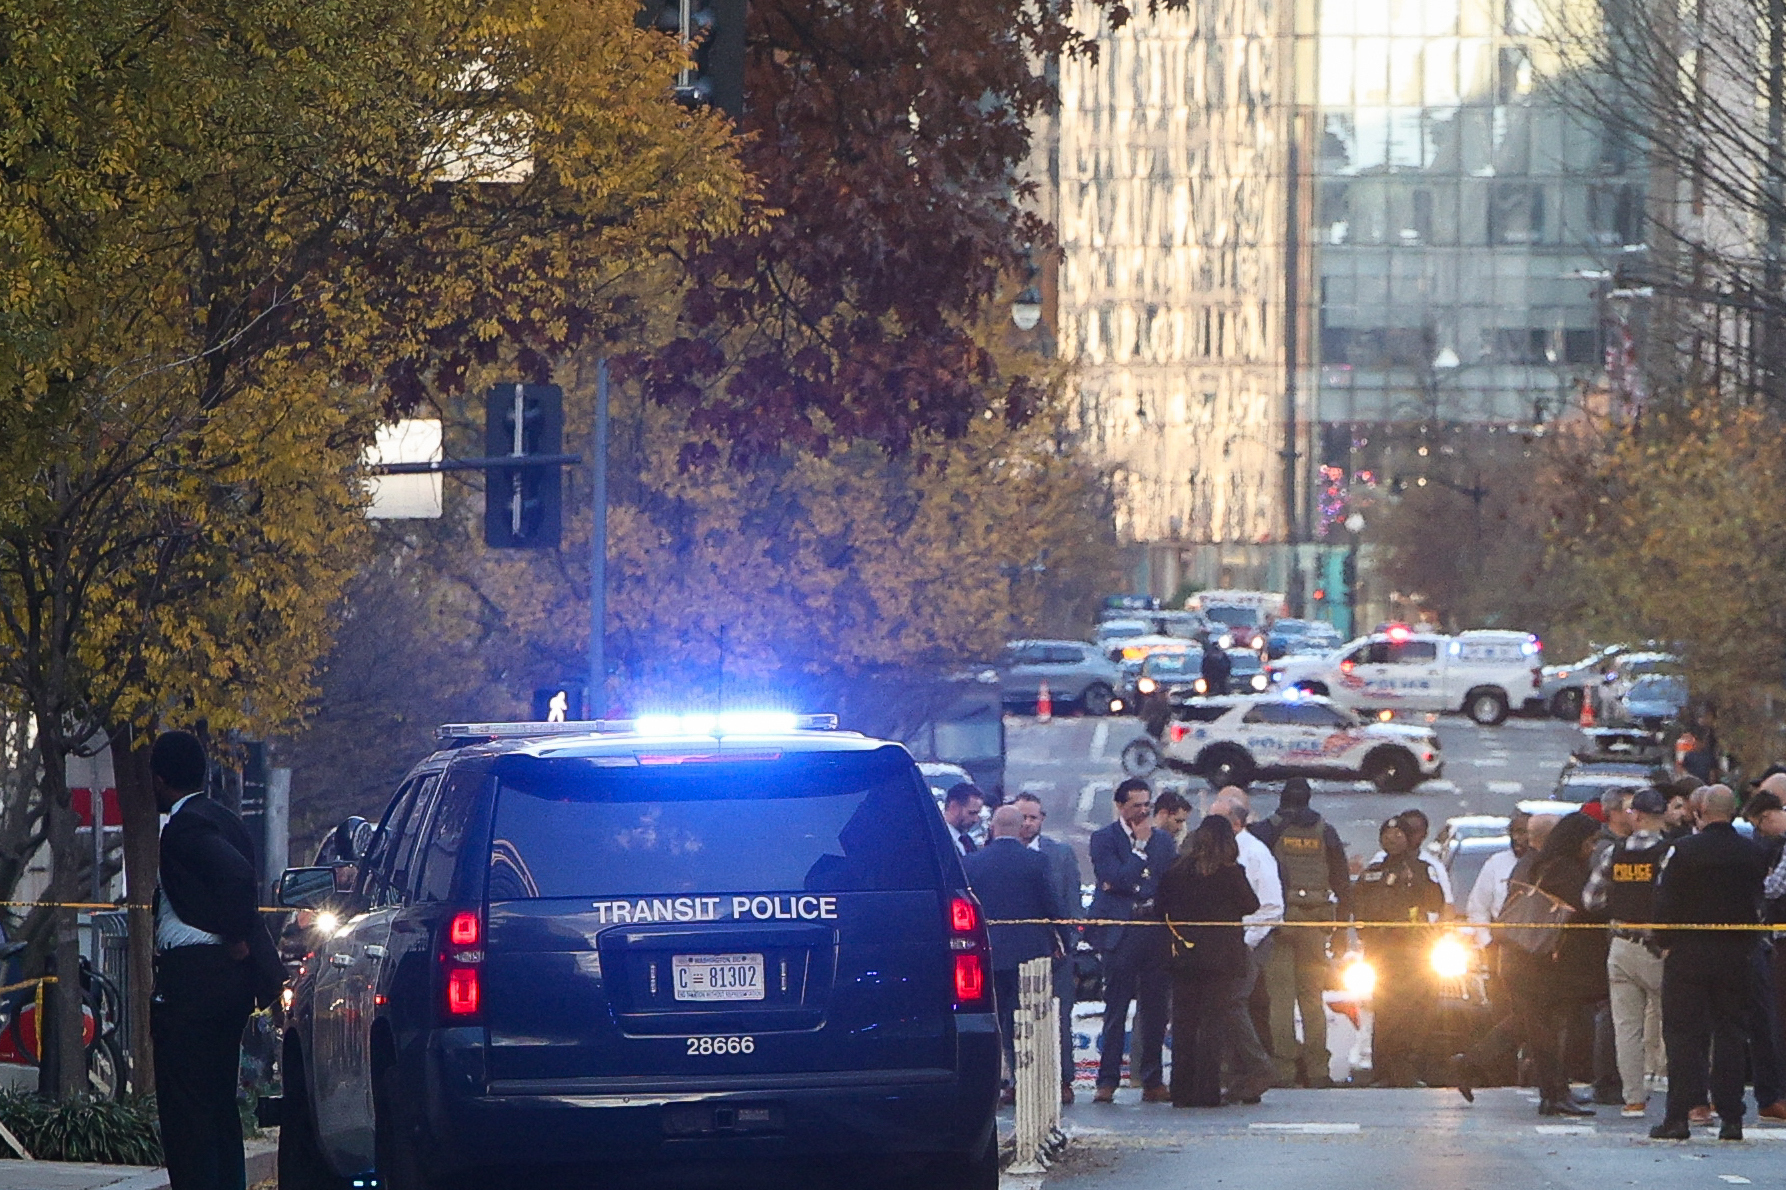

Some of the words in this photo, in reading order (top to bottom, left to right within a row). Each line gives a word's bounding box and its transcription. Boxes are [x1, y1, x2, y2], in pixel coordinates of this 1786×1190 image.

[1613, 863, 1653, 876] POLICE
[592, 898, 720, 923] TRANSIT
[732, 897, 838, 919] POLICE
[679, 968, 688, 988] C
[709, 966, 757, 988] 81302
[686, 1036, 755, 1055] 28666
